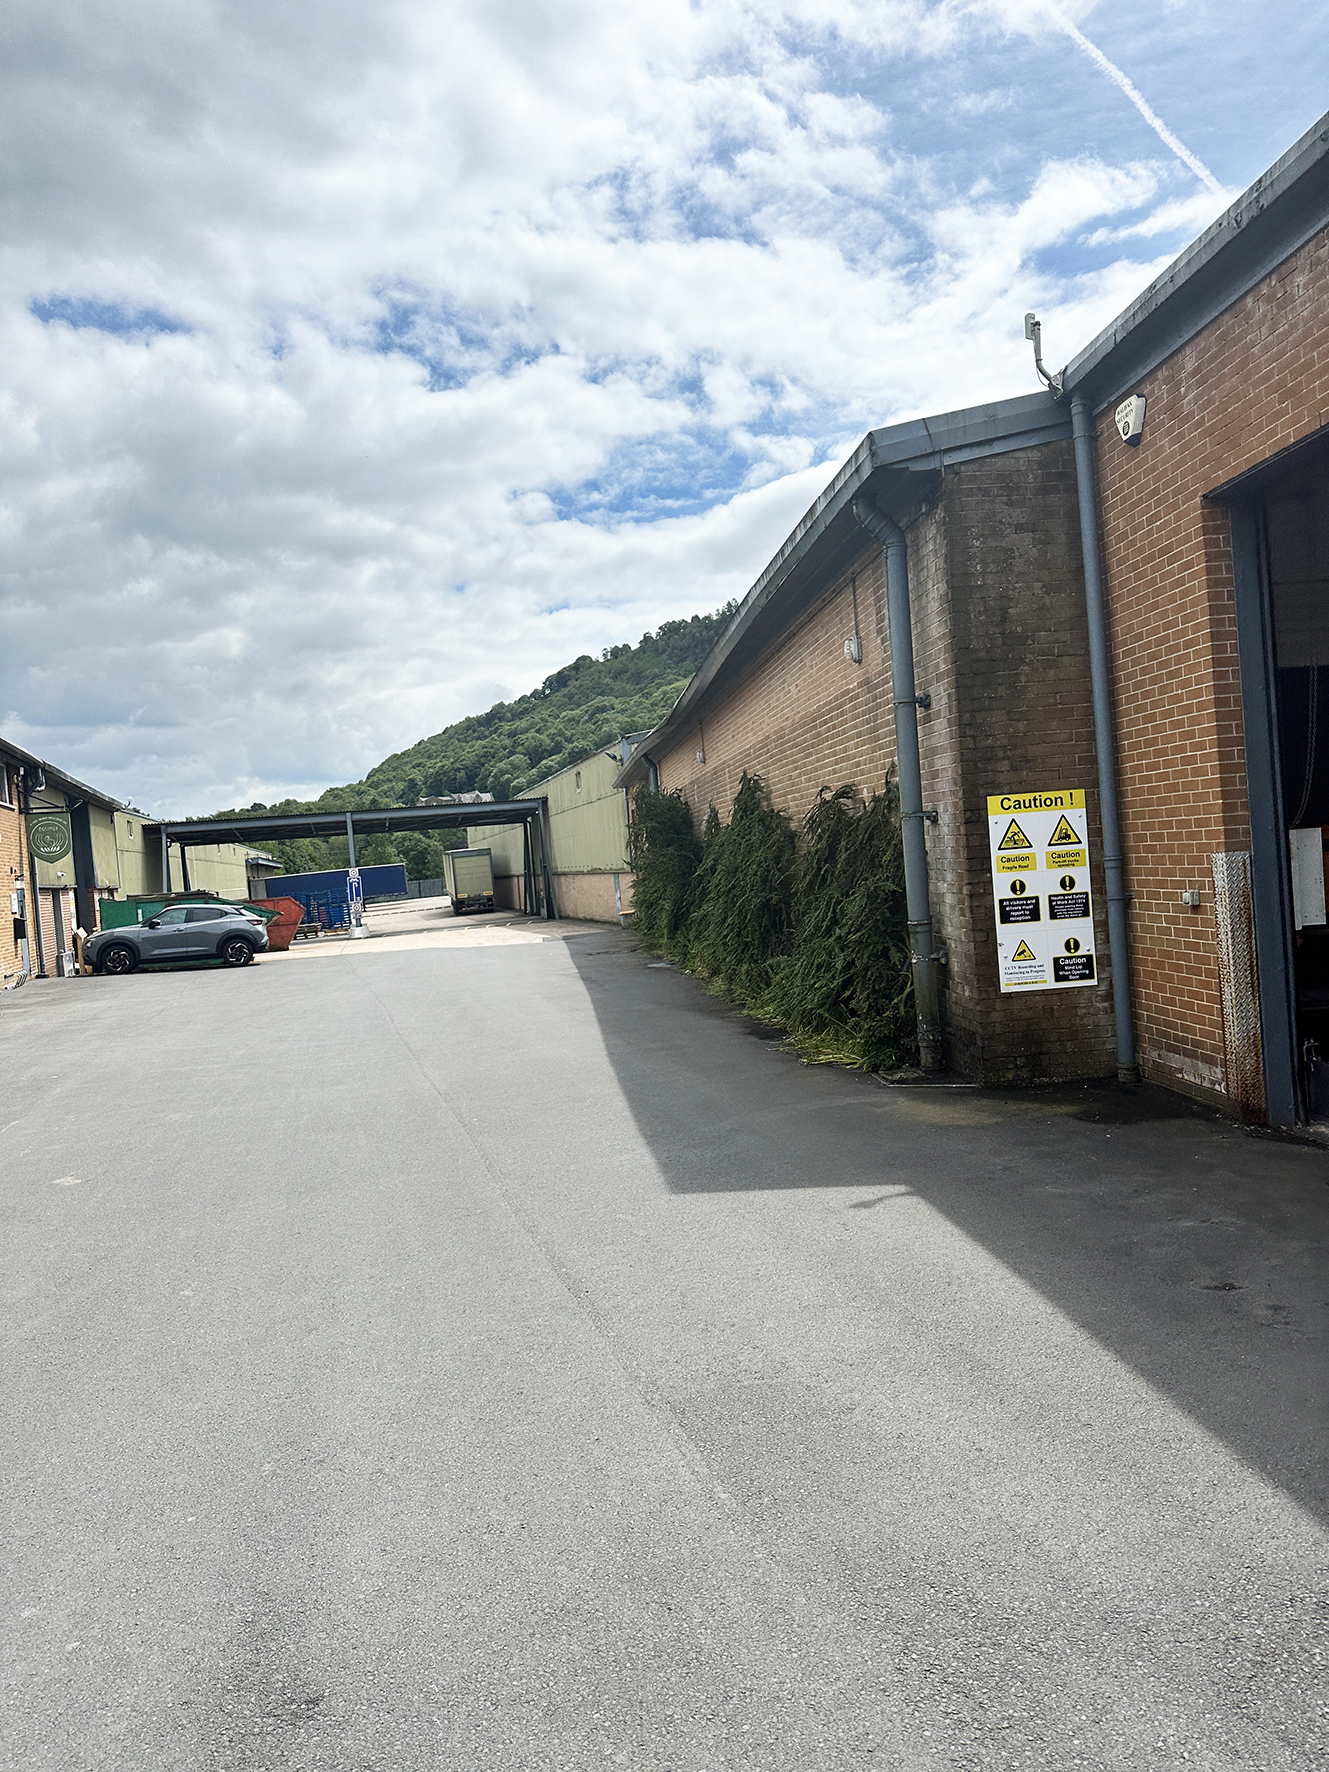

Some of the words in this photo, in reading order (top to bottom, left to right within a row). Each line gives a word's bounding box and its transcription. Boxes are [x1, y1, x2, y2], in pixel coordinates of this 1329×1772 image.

[1000, 794, 1064, 811] Caution
[1069, 791, 1074, 805] !
[1000, 855, 1030, 863] Caution
[1051, 851, 1081, 859] Caution
[1059, 957, 1087, 965] Caution
